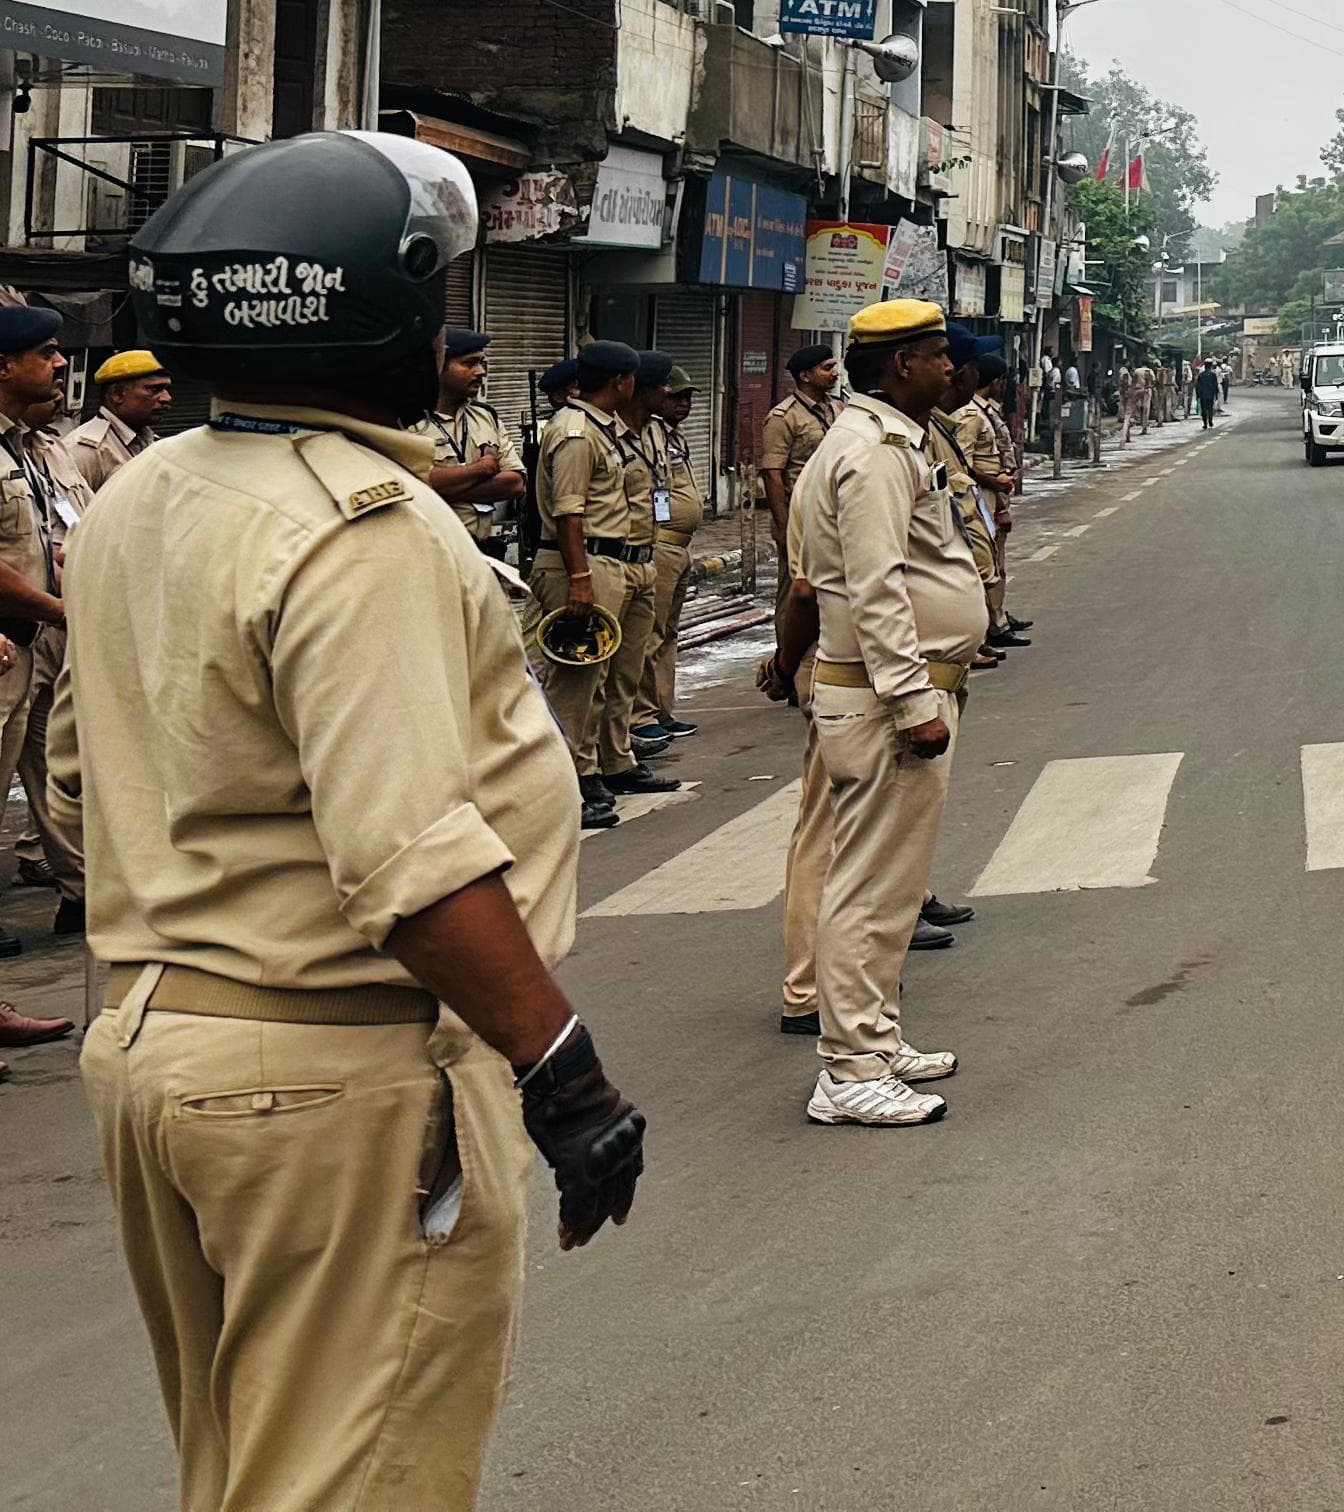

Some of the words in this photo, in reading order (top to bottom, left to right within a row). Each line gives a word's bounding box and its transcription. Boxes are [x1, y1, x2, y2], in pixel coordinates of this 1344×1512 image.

[212, 256, 293, 294] તમારી
[295, 262, 347, 294] જાન
[223, 295, 330, 329] બચાવીશ
